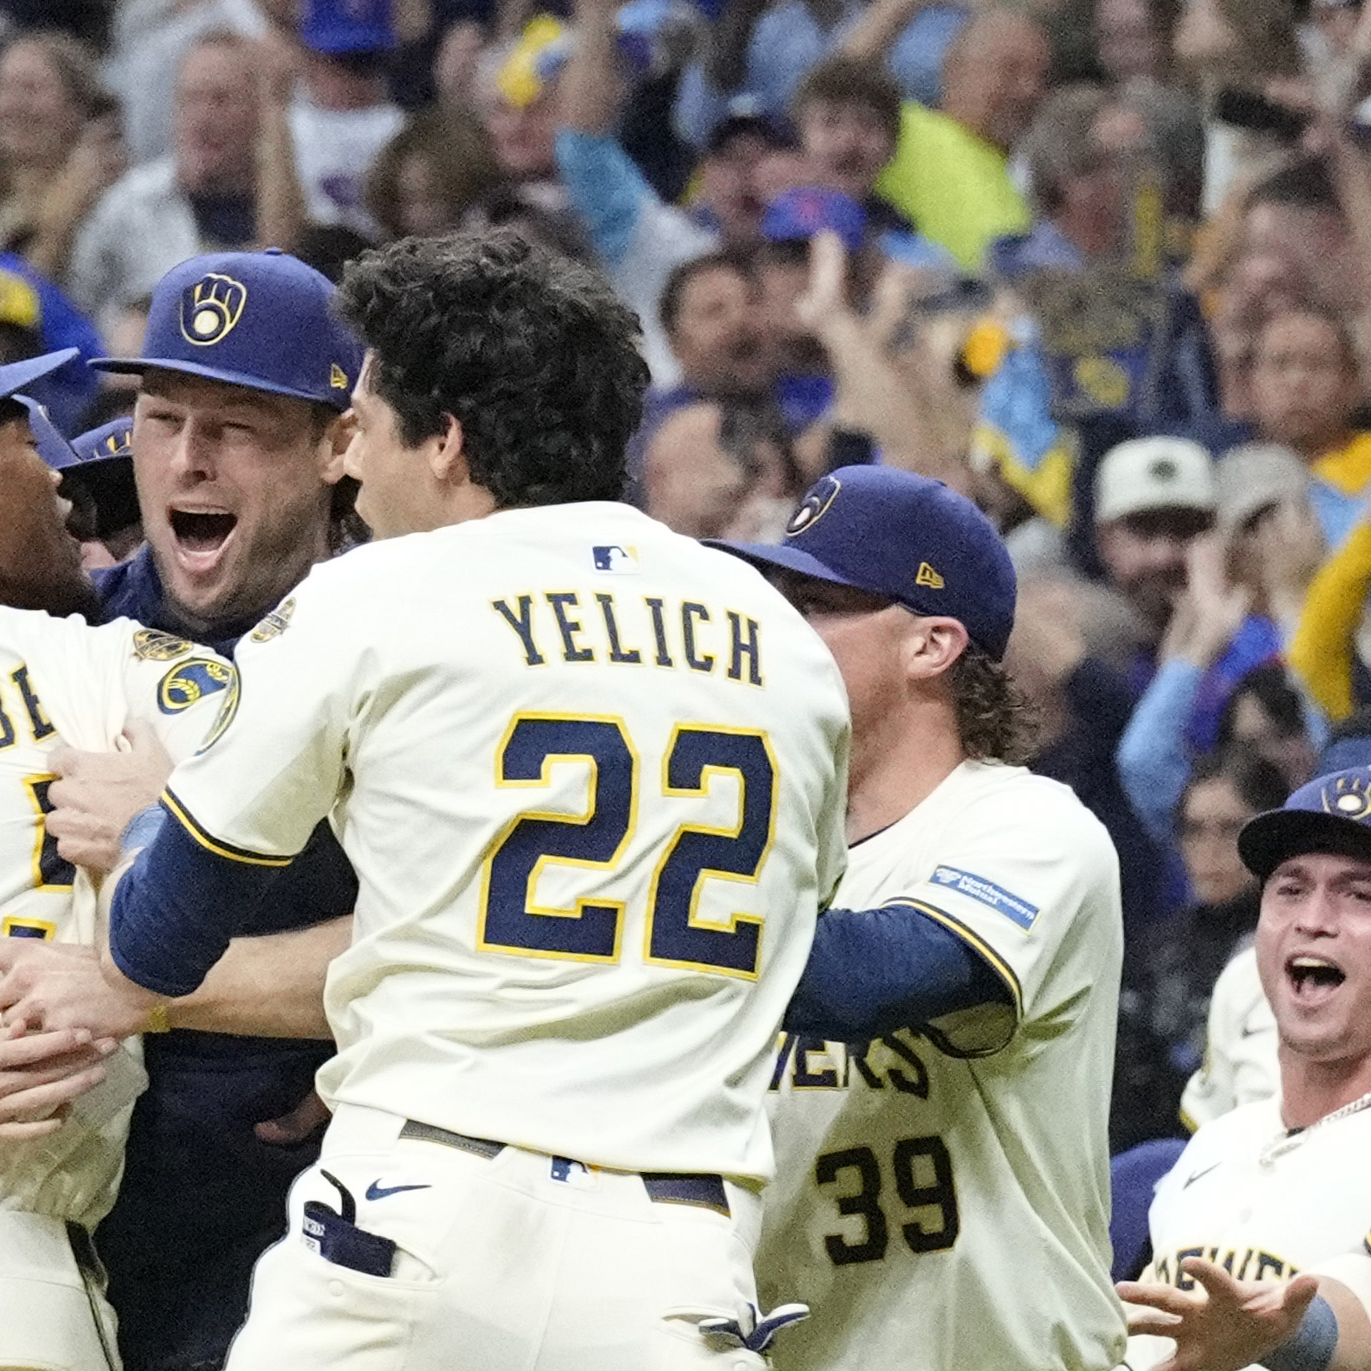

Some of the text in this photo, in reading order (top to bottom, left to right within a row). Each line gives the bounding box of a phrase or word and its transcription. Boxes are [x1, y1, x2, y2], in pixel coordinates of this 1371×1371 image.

[492, 592, 766, 689] YELICH
[476, 710, 779, 981] 22
[815, 1134, 961, 1266] 39
